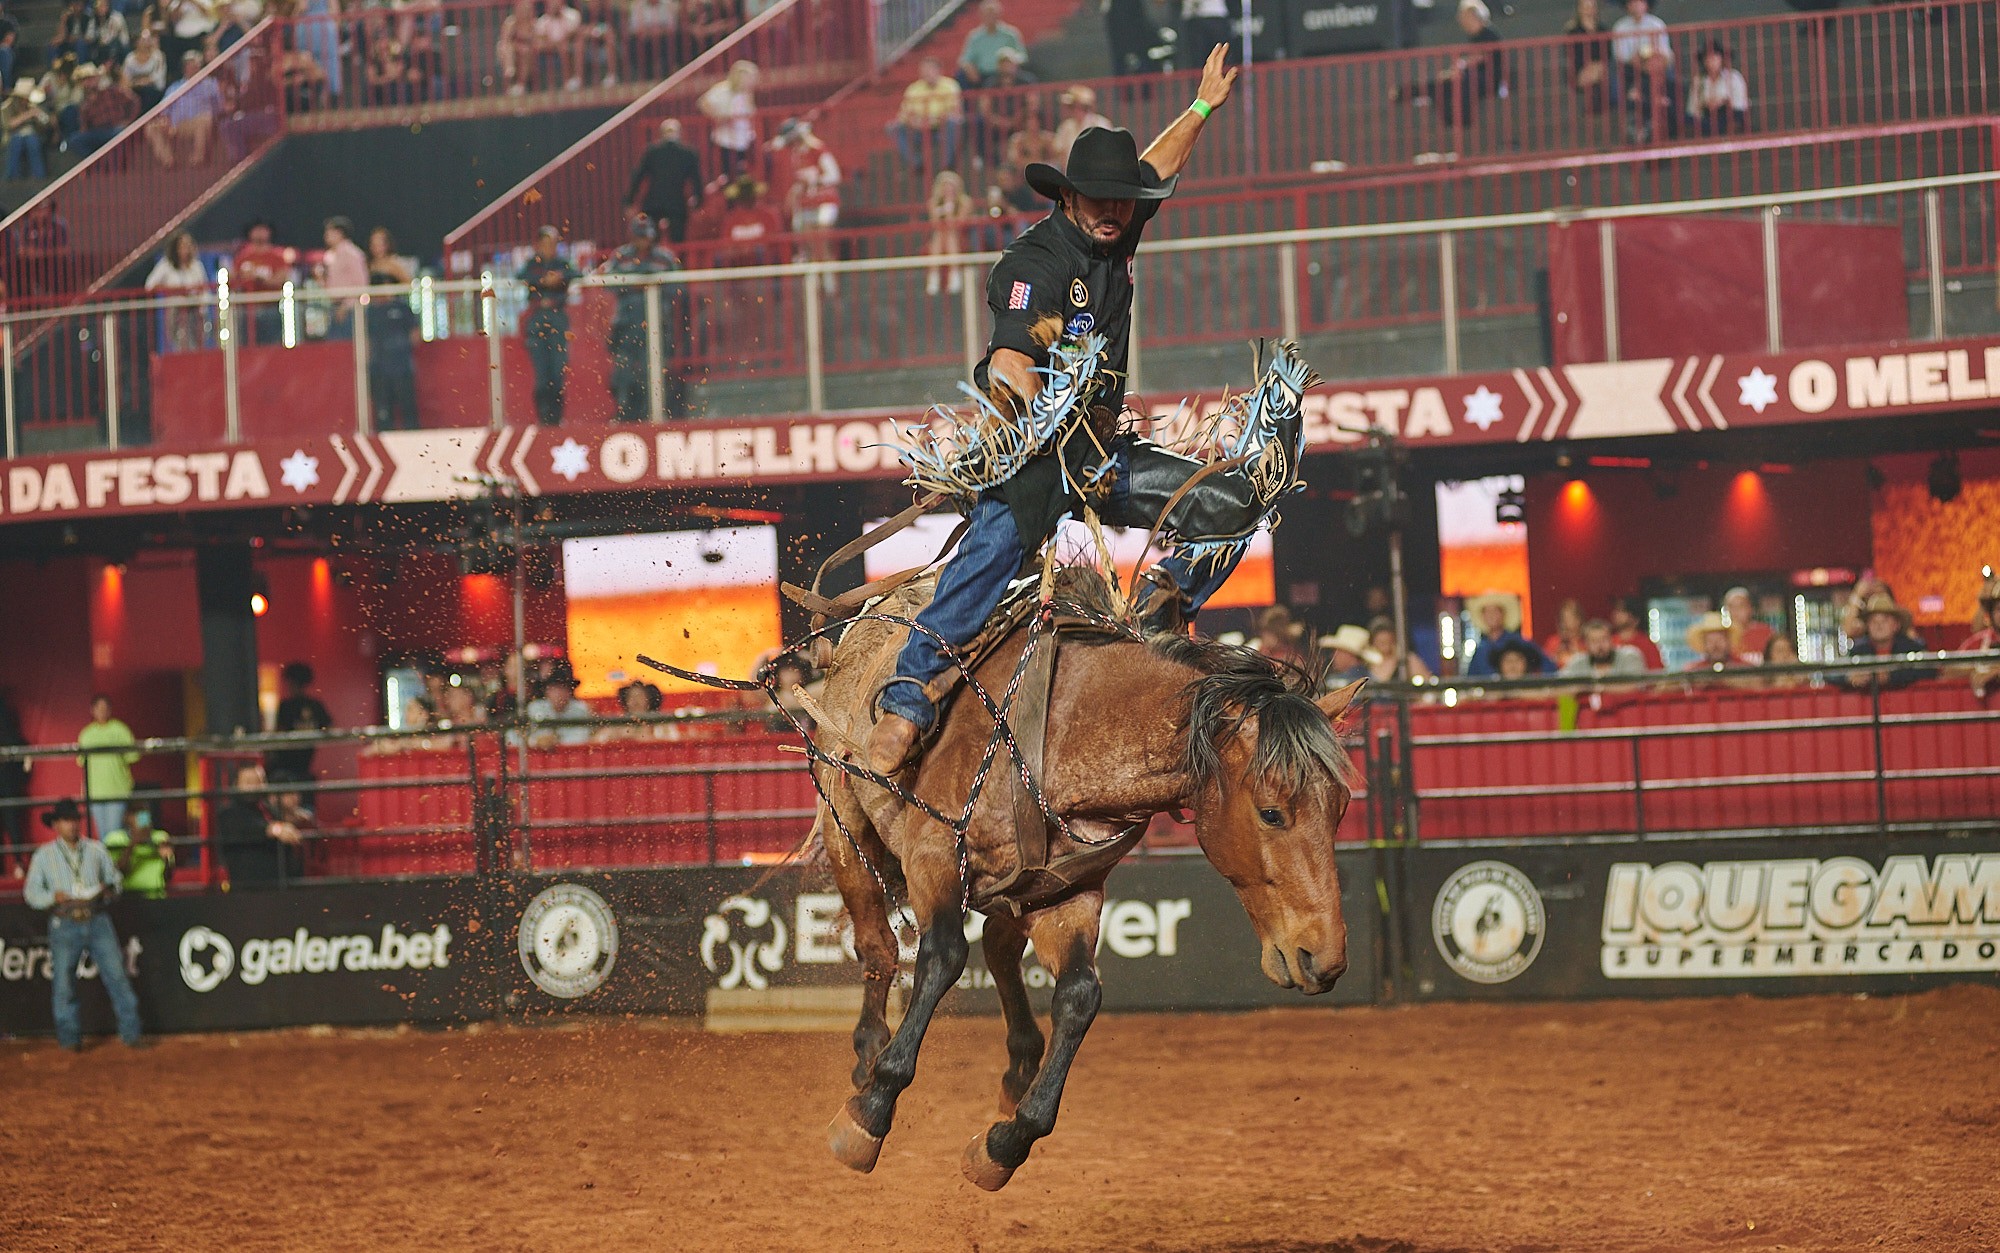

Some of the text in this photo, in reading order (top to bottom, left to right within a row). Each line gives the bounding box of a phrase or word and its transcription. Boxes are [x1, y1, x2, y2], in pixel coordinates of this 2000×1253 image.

[1788, 359, 1838, 414] O
[1300, 386, 1454, 444] ESTA
[9, 450, 271, 515] DA FESTA
[599, 431, 649, 483] O
[240, 923, 452, 985] galera.bet
[1617, 942, 1996, 967] SUPERMERCADO
